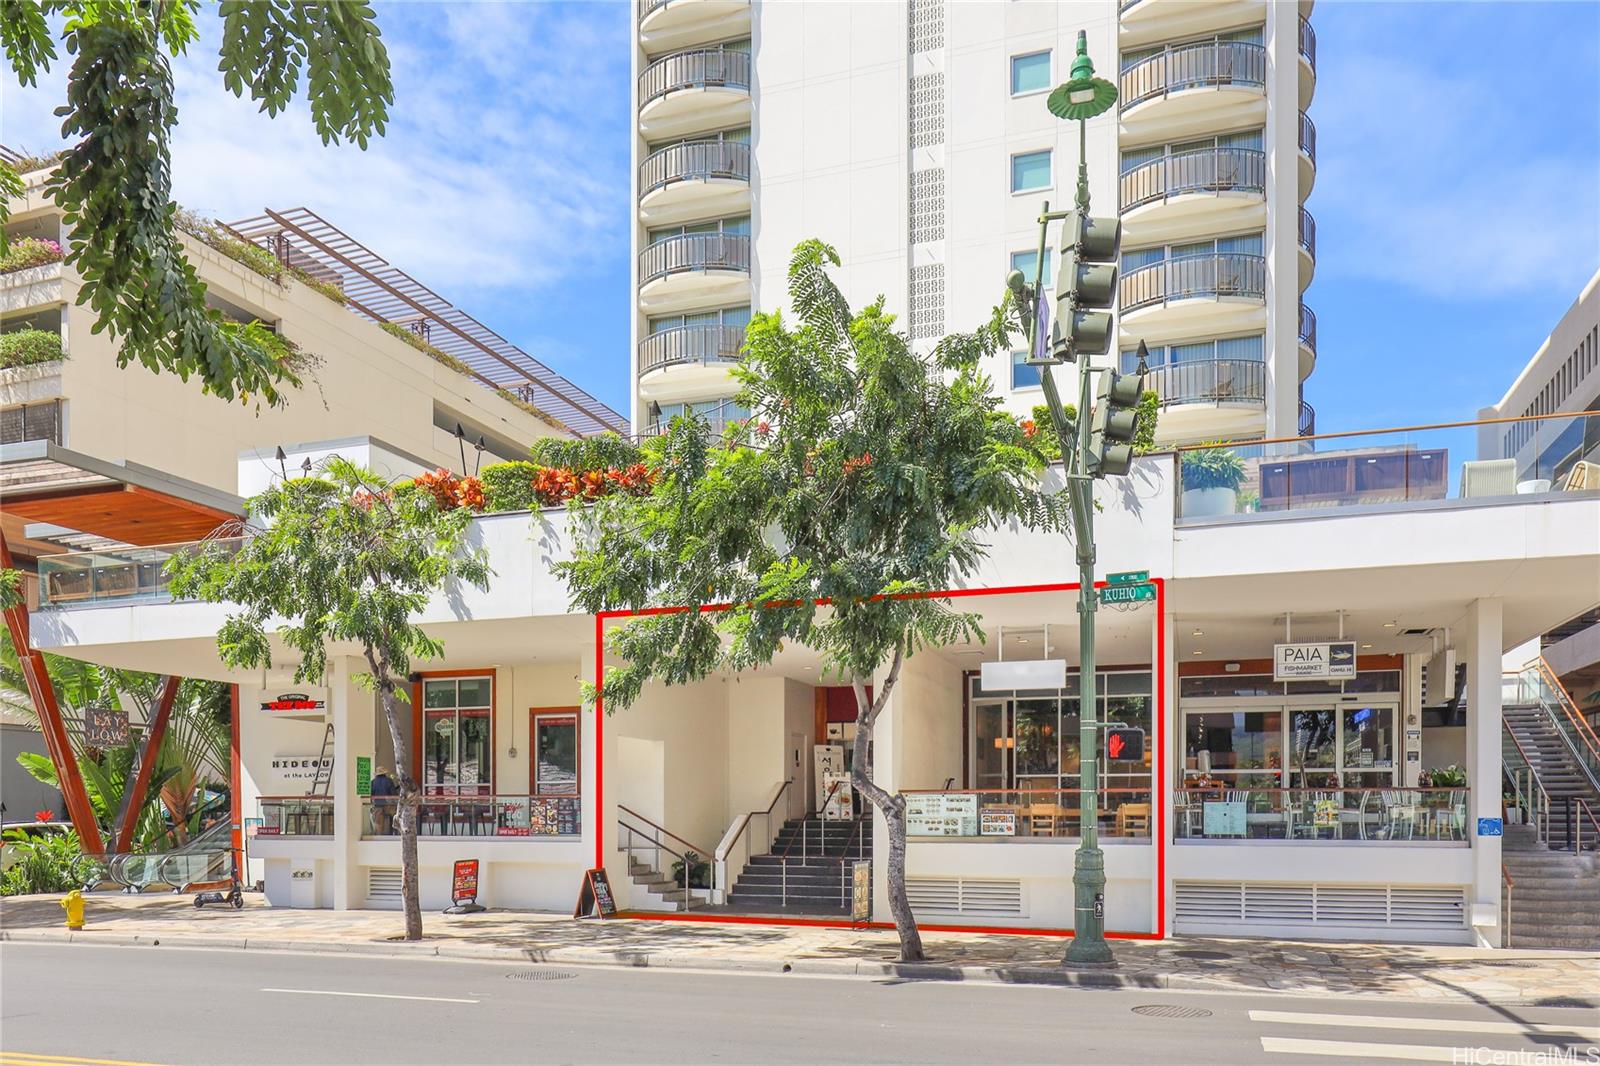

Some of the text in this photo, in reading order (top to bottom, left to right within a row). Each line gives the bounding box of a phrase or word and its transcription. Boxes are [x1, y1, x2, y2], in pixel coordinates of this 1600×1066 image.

[1104, 587, 1136, 601] KUHIO
[1284, 647, 1322, 662] PAIA
[1284, 664, 1322, 672] FISHMARKET
[94, 714, 121, 727] LAY
[92, 729, 123, 741] LOW
[272, 760, 330, 769] HIDEOU
